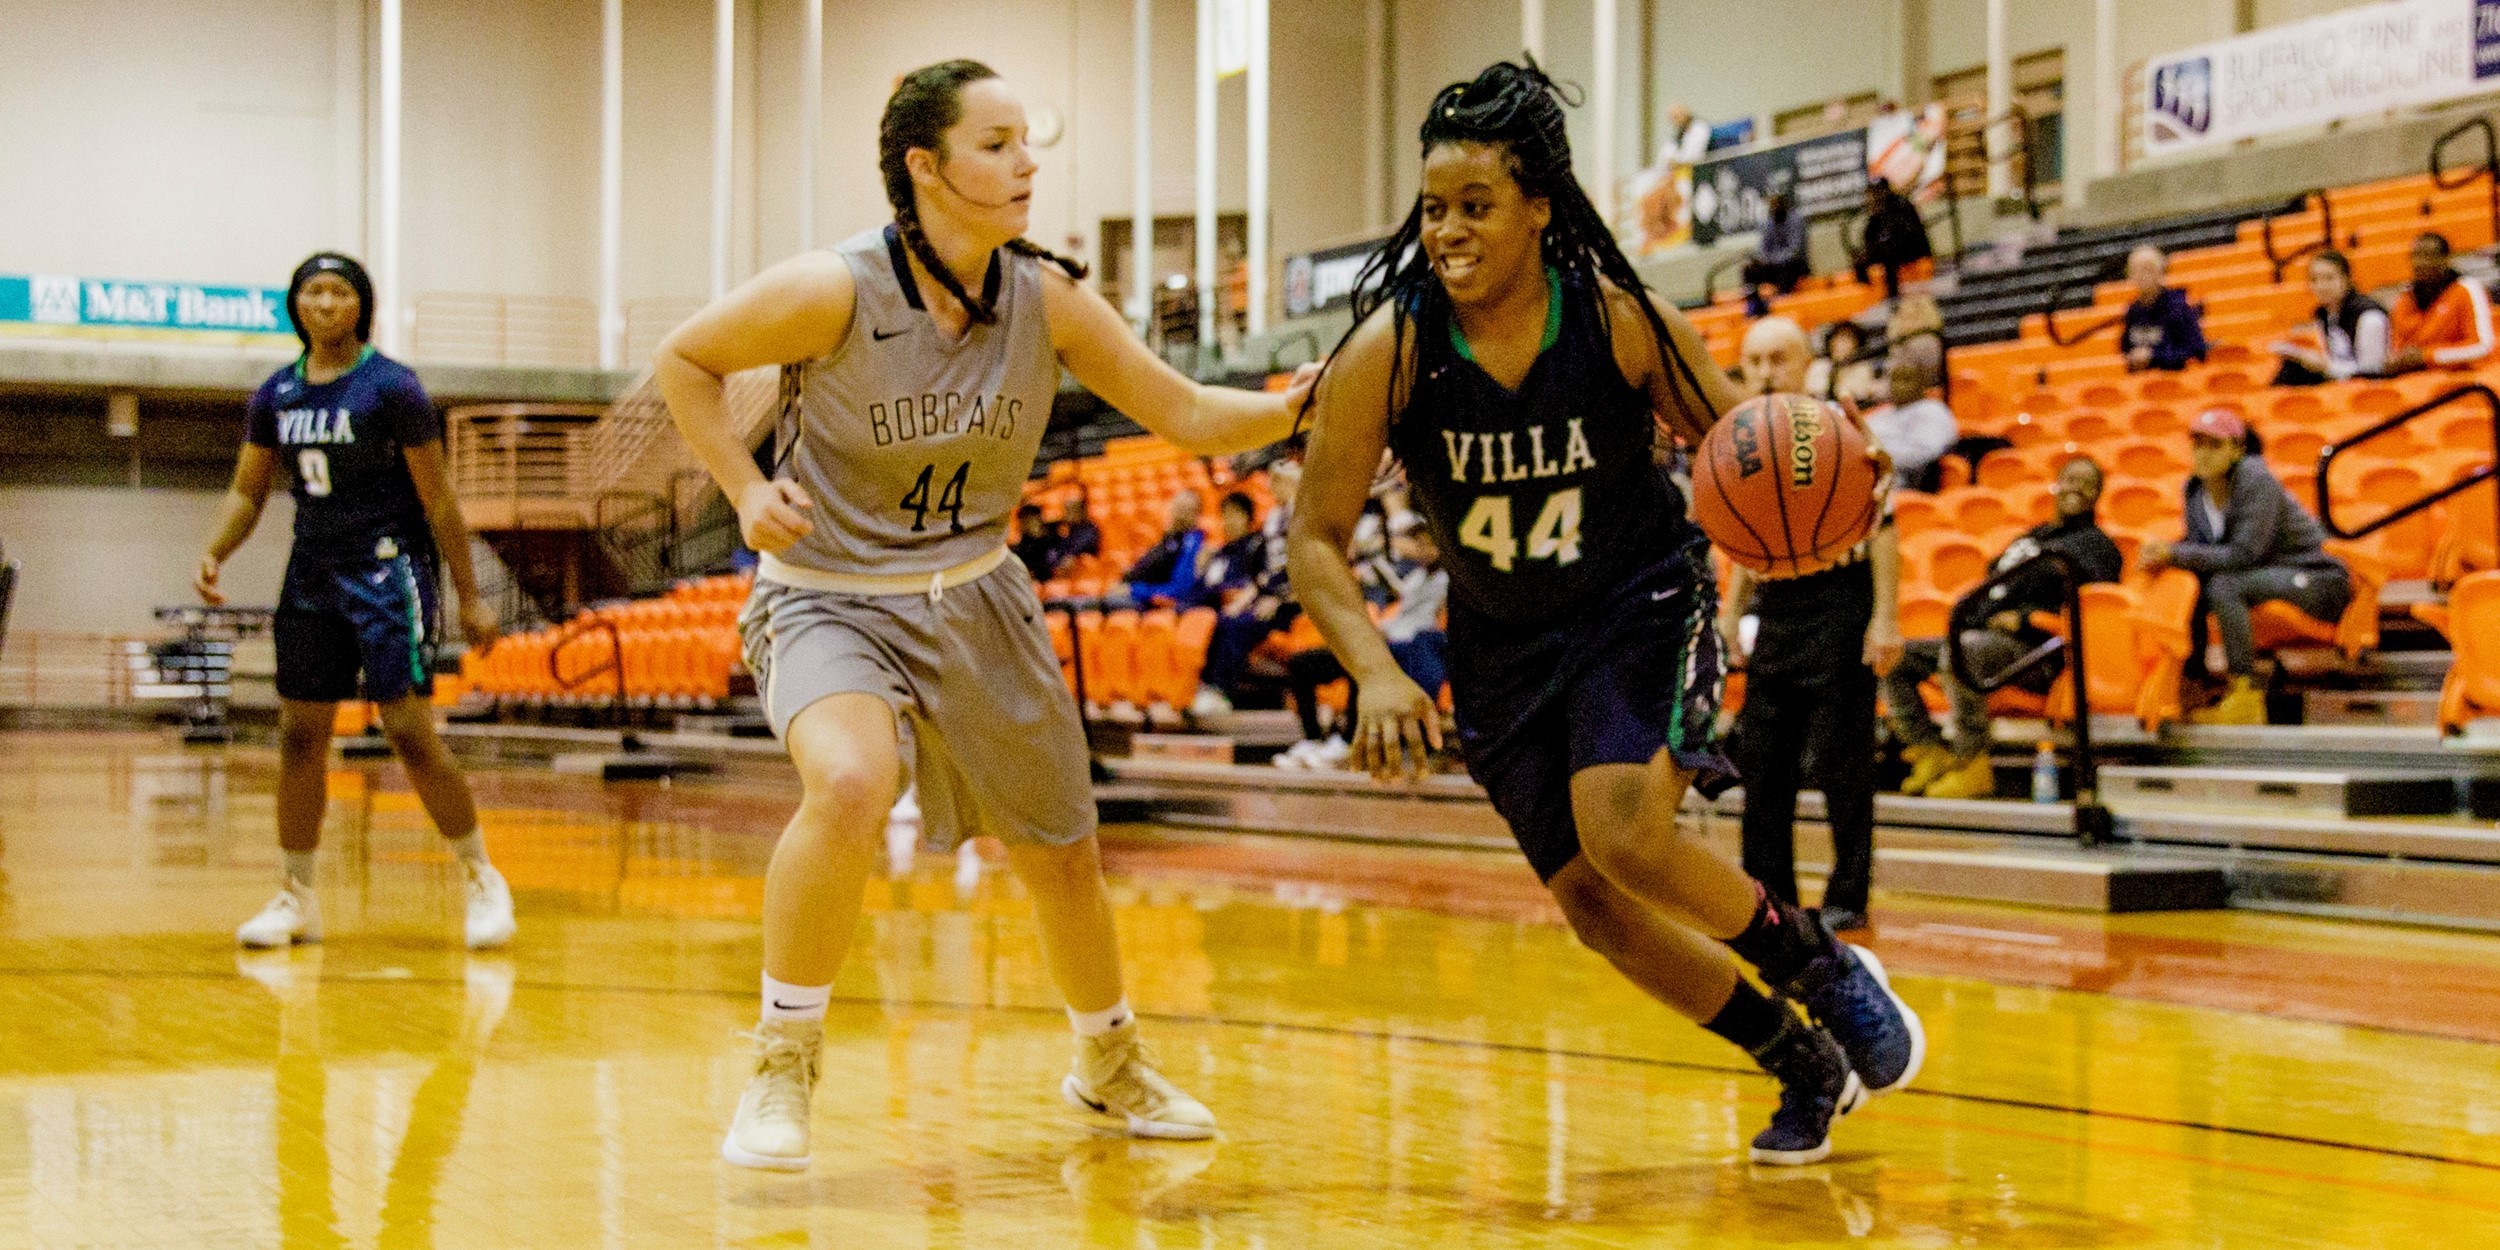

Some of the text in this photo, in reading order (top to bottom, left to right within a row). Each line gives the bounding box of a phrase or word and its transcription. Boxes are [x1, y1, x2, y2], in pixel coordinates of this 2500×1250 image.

[85, 280, 279, 329] M&T Bank
[276, 408, 356, 445] VILLA
[869, 391, 1023, 446] BOBCATS
[298, 448, 332, 498] 0
[1442, 417, 1597, 484] VILLA
[900, 461, 971, 535] 44
[1458, 487, 1586, 572] 44
